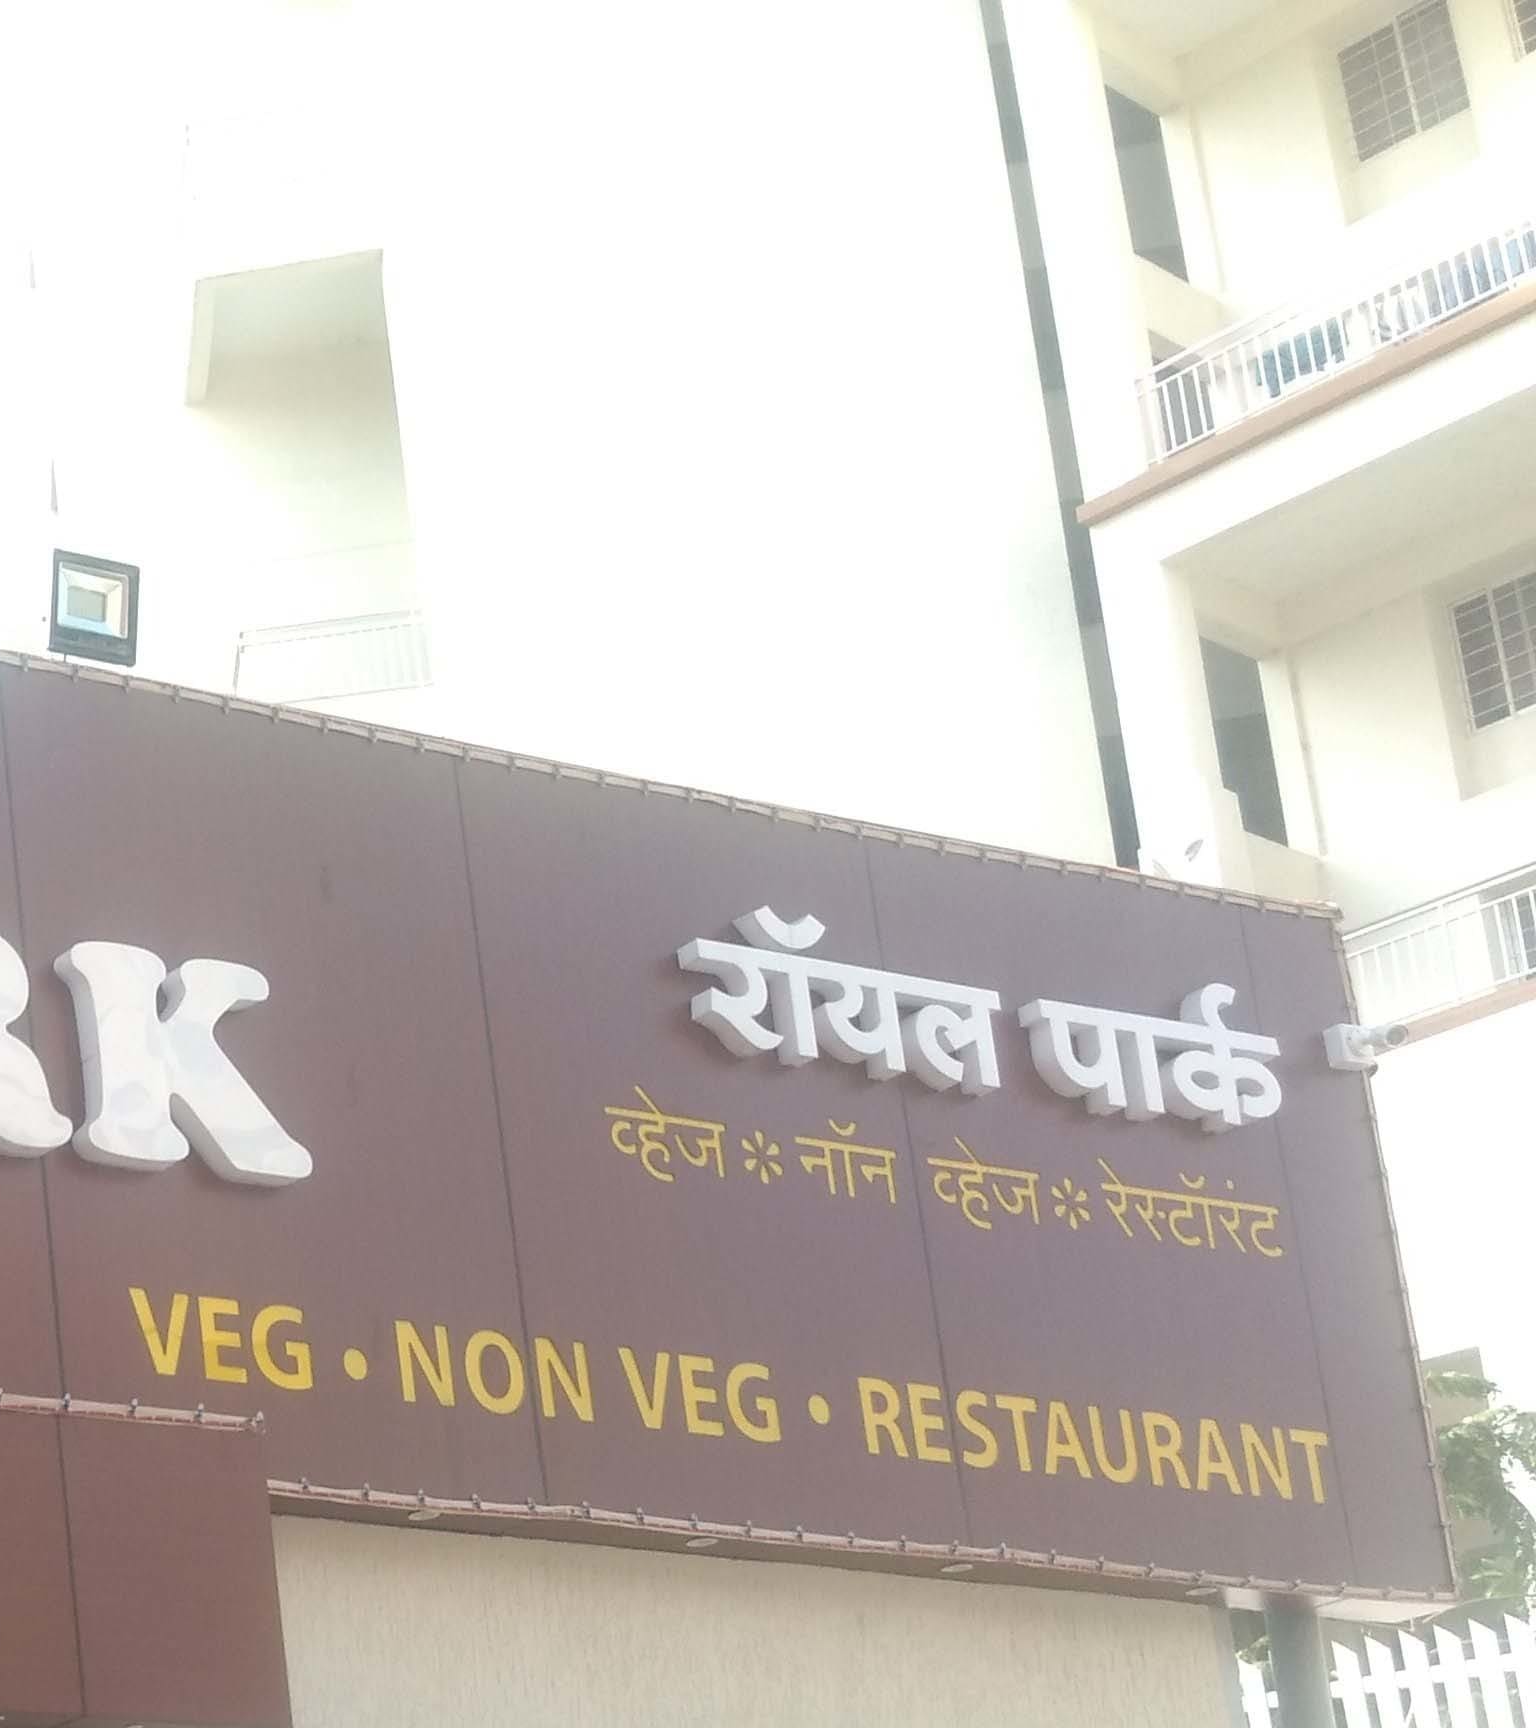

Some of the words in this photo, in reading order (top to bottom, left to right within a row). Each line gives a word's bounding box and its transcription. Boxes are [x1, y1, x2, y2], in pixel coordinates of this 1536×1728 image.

[676, 905, 1002, 1098] रॉयल
[1017, 983, 1282, 1133] पार्क
[604, 1086, 725, 1183] व्हेज
[794, 1119, 897, 1204] नॉन
[927, 1136, 1040, 1230] व्हेज
[1098, 1158, 1284, 1258] रेस्टॉरंट
[130, 1288, 316, 1391] VEG
[394, 1319, 596, 1421] NON
[618, 1346, 783, 1443] VEG
[858, 1376, 1330, 1504] RESTAURANT
